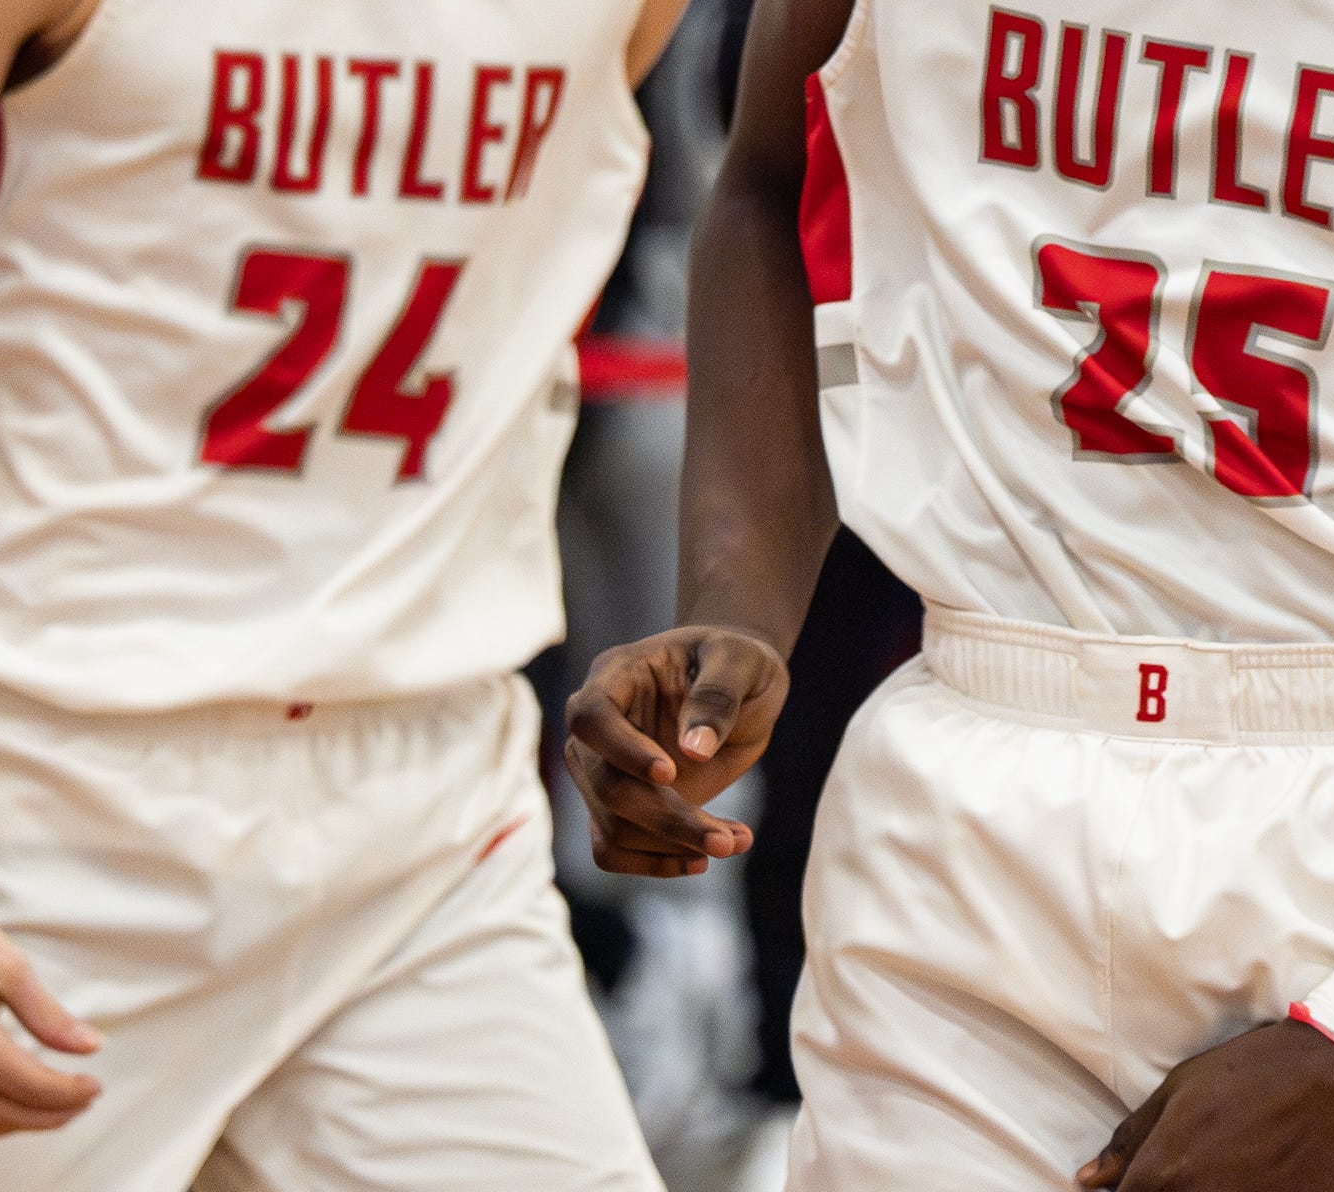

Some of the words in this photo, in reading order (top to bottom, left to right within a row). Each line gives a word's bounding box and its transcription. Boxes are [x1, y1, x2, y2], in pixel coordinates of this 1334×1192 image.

[196, 49, 567, 204] BUTLER
[196, 243, 471, 484] 24
[1136, 663, 1168, 723] B
